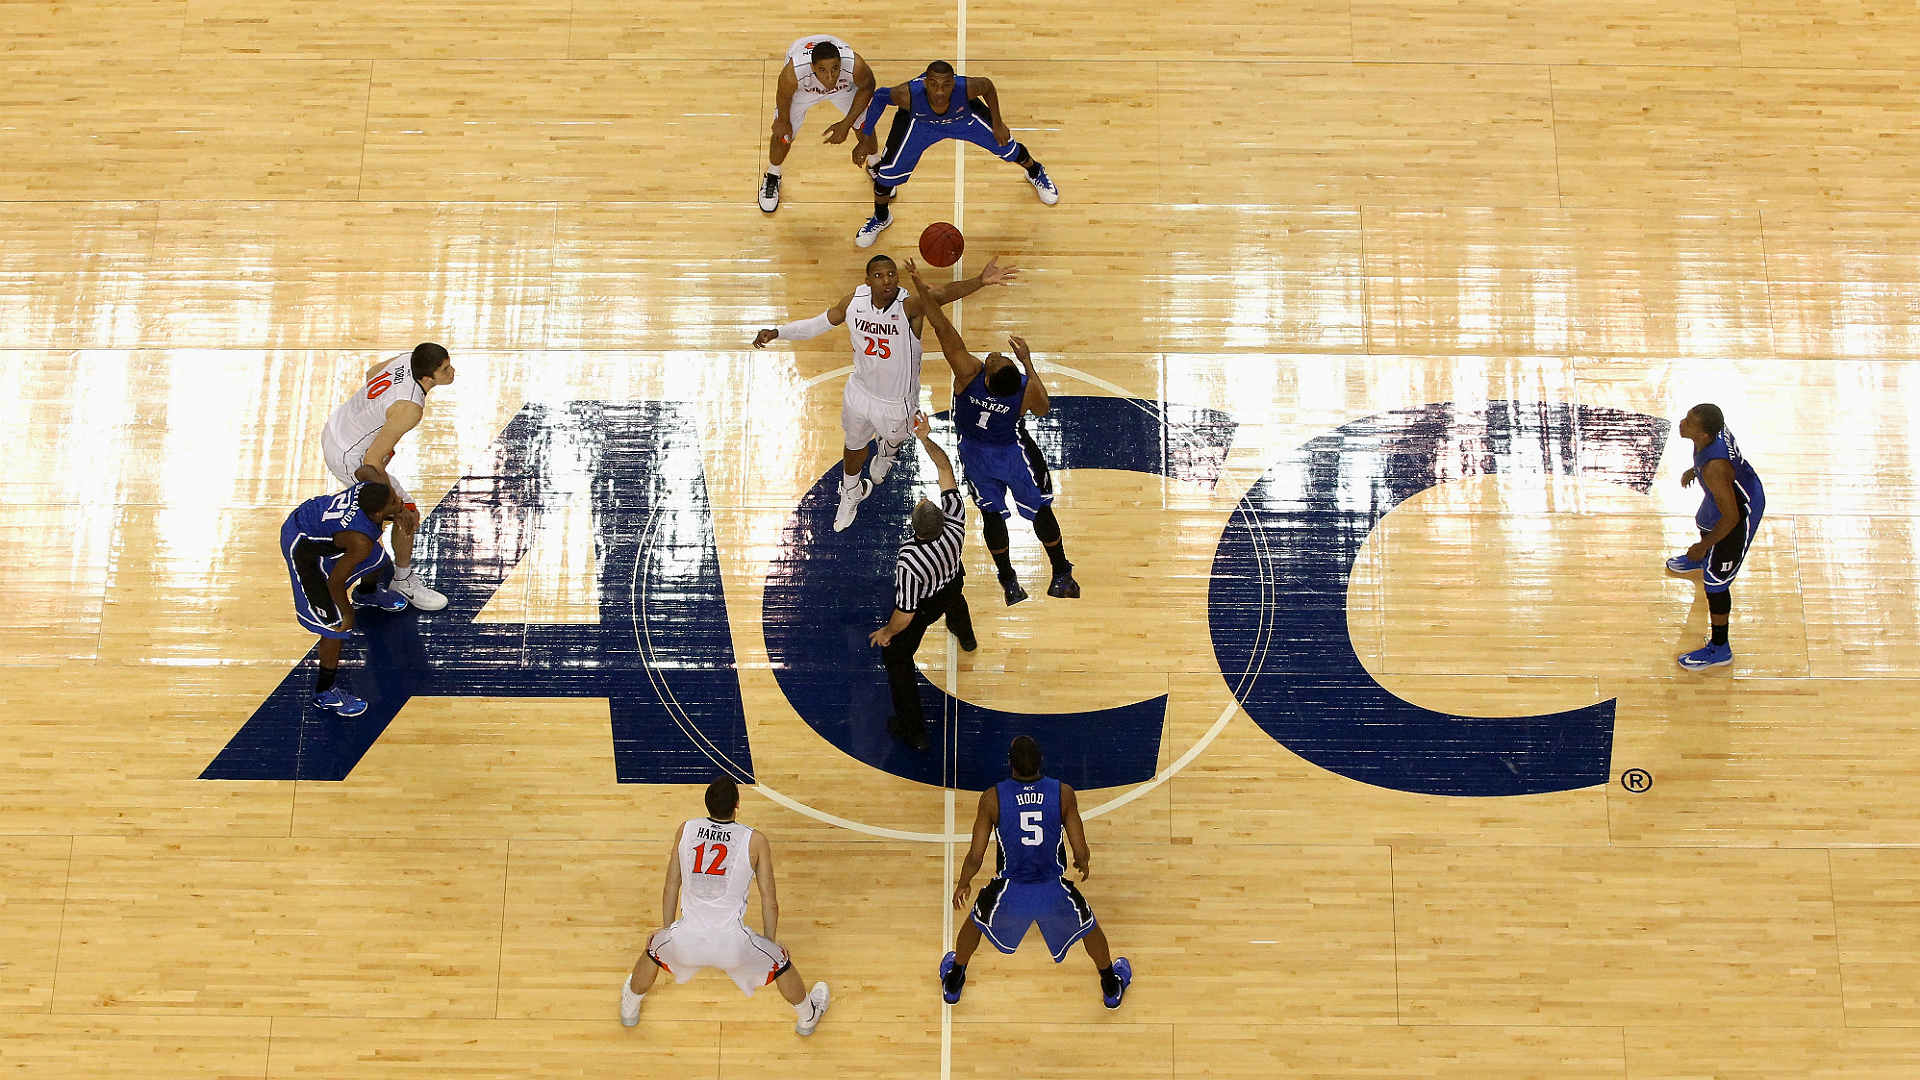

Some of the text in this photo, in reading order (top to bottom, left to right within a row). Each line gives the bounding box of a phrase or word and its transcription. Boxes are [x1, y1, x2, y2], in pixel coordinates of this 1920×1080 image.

[855, 317, 899, 335] VIRGINIA
[864, 336, 891, 359] 25
[367, 371, 392, 399] 10
[969, 395, 1010, 414] PARKER
[976, 411, 991, 430] 1
[321, 490, 352, 522] 21
[197, 396, 1671, 797] ACC
[1015, 792, 1044, 805] HOOD
[696, 827, 732, 842] HARRIS
[1020, 811, 1043, 846] 5
[692, 841, 728, 876] 12
